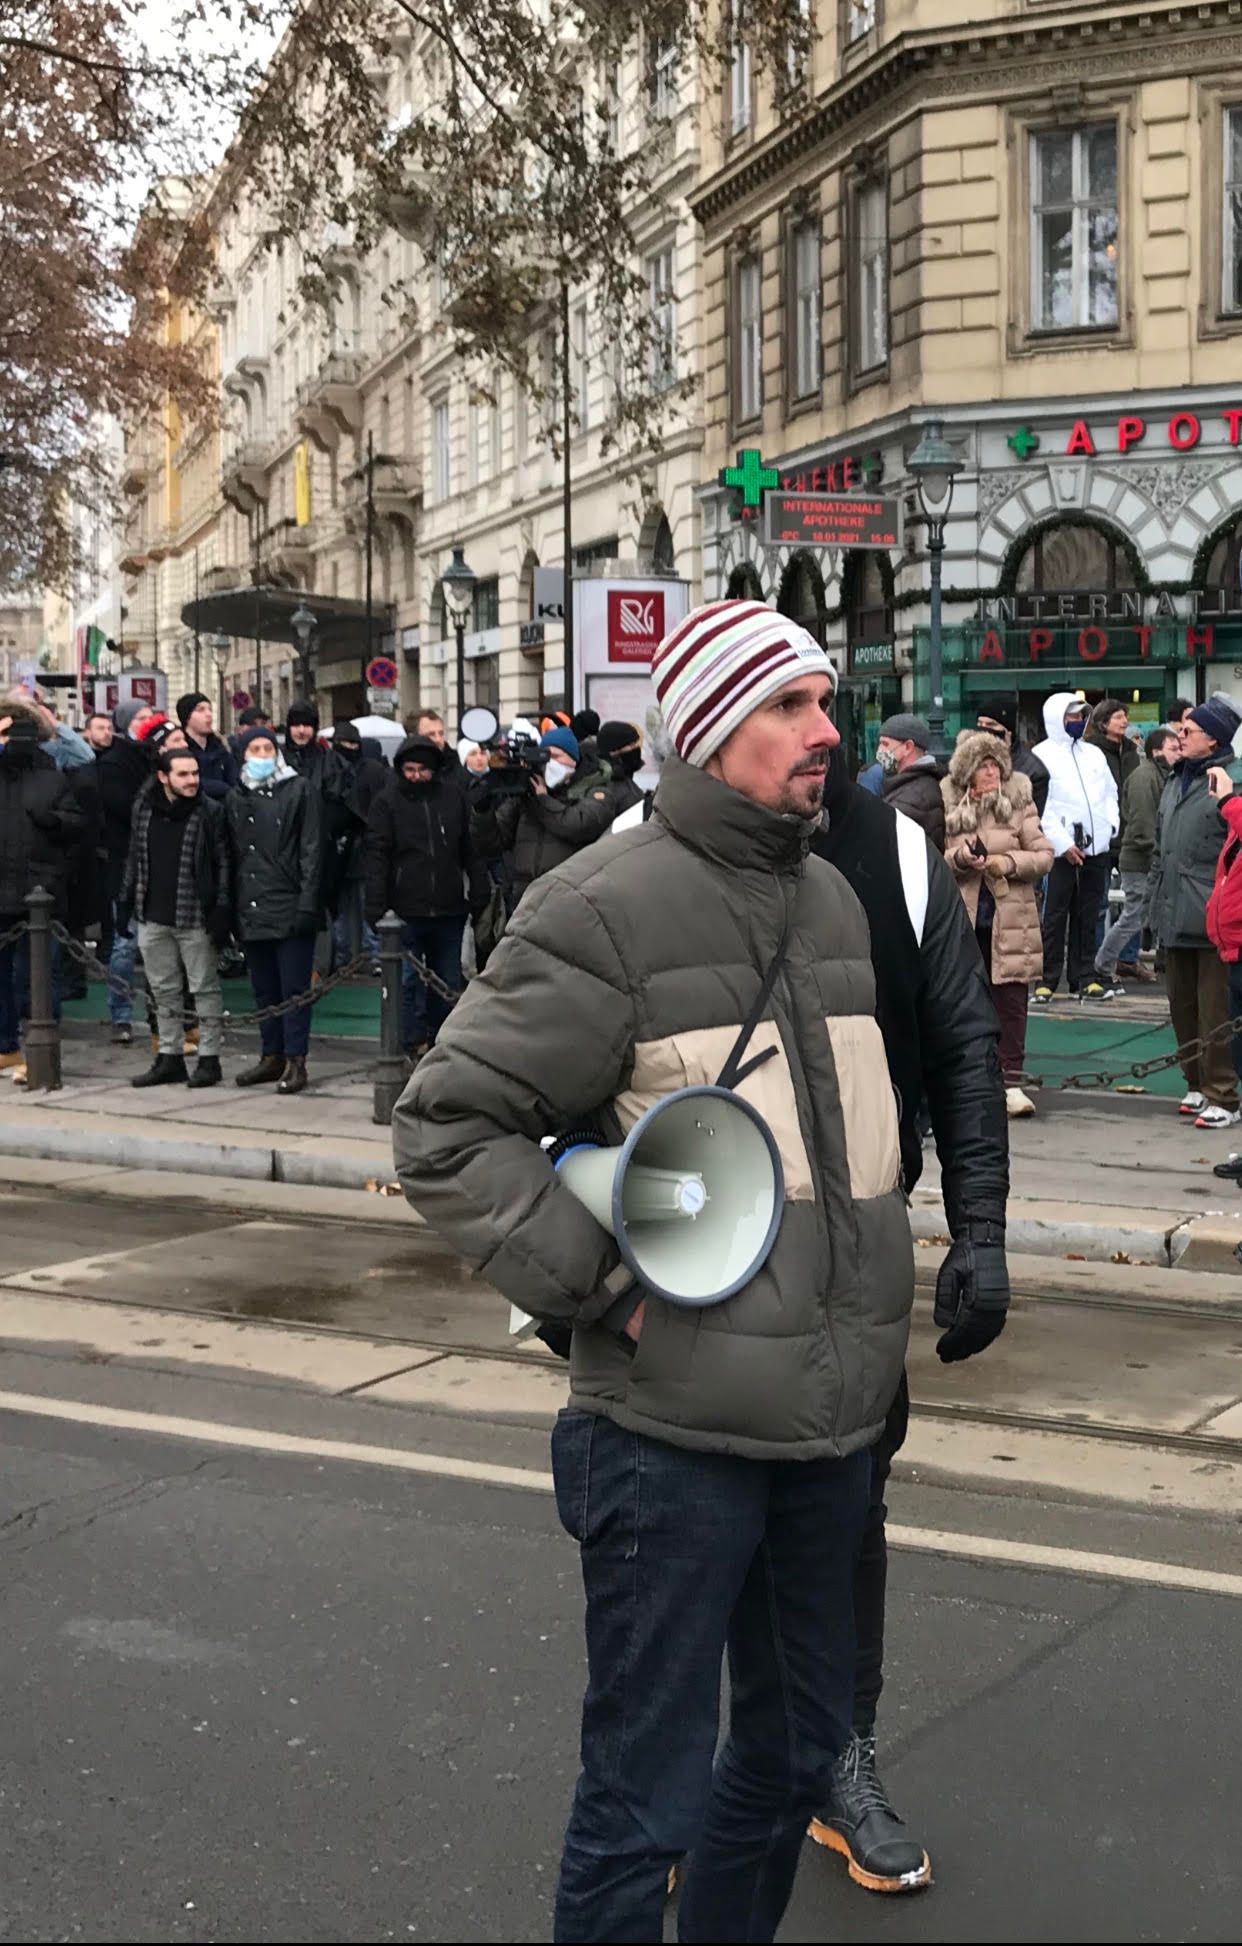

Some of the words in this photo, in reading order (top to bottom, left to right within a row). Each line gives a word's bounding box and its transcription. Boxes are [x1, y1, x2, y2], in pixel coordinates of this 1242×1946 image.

[1066, 410, 1242, 455] APOT
[783, 501, 882, 515] INTERNATIONALE
[803, 515, 865, 527] APOTHEKE
[979, 589, 1226, 621] INTERNATI
[855, 644, 892, 664] APOTHEKE
[979, 623, 1214, 663] APOTH
